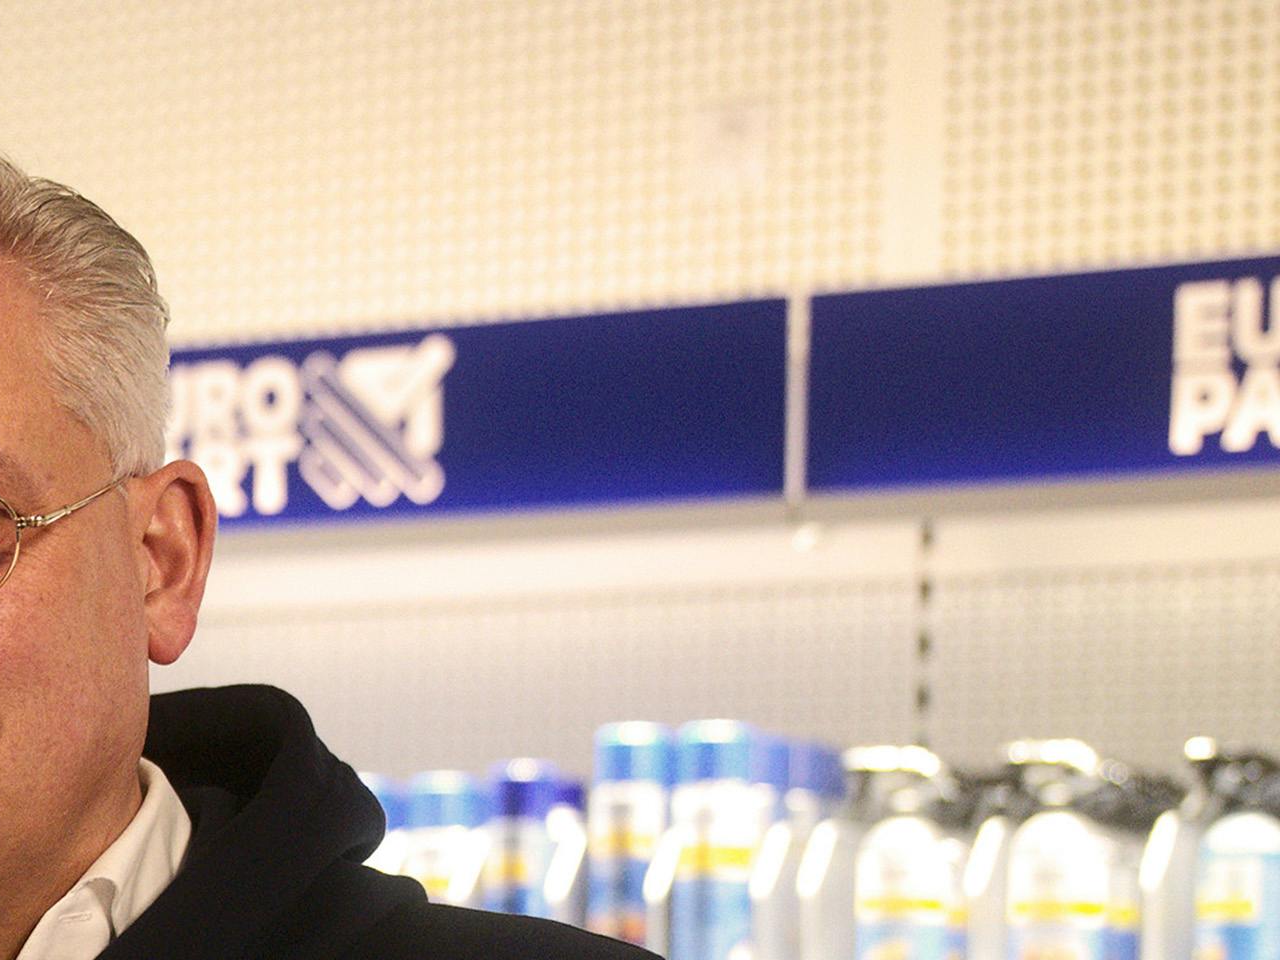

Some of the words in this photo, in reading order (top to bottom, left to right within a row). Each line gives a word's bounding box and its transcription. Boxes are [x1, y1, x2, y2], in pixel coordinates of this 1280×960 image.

[1173, 275, 1280, 363] EU
[166, 356, 301, 437] RO
[1168, 368, 1280, 456] PA
[165, 436, 305, 517] RT
